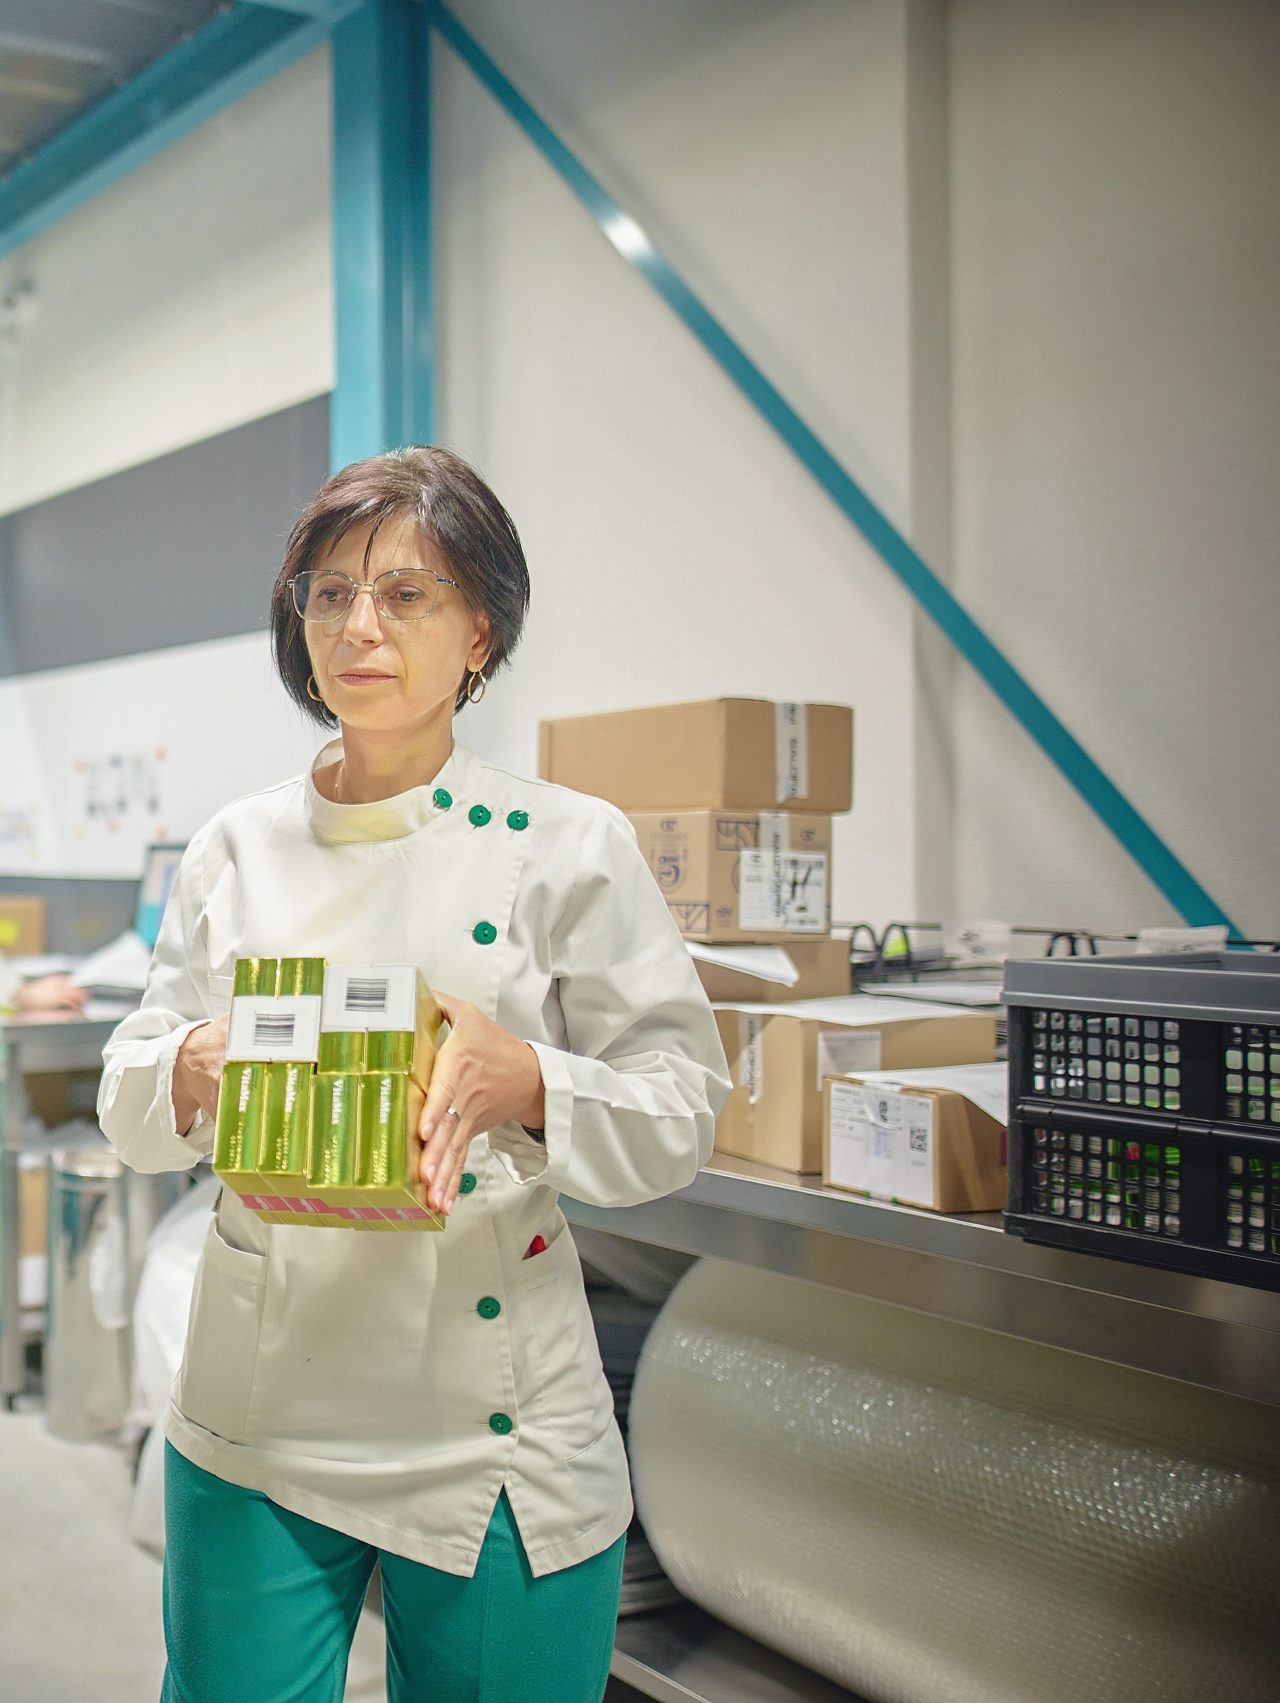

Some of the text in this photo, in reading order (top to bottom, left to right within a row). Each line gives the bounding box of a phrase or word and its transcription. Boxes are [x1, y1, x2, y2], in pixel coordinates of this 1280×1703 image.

[238, 1067, 252, 1112] VitaMax
[285, 1068, 298, 1113] VitaMax
[331, 1078, 344, 1125] VitaMax
[379, 1077, 392, 1125] VitaMax
